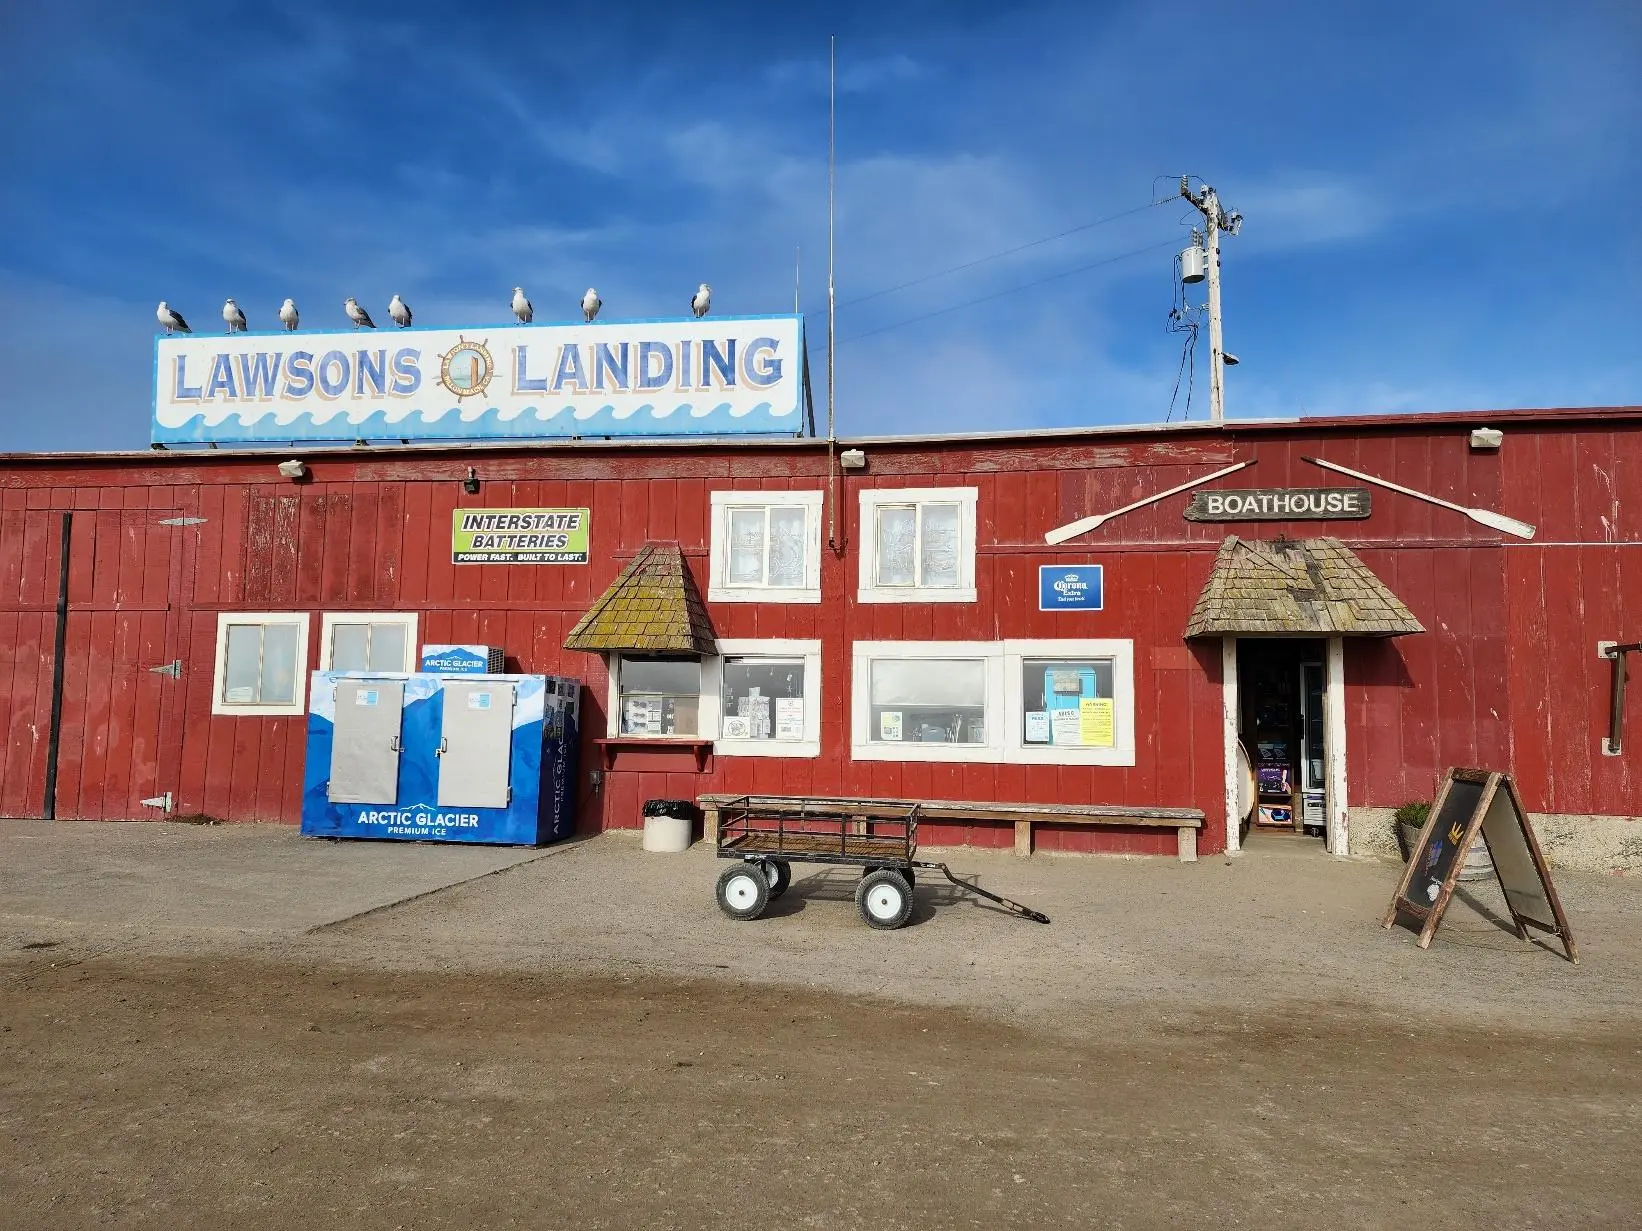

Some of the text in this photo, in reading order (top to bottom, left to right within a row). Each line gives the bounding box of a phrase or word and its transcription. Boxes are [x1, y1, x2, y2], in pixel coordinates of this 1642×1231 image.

[172, 336, 784, 402] LAWSONS LANDING
[1207, 493, 1360, 514] BOATHOUSE
[462, 514, 580, 530] INTERSTATE
[472, 534, 568, 549] BATTERIES
[458, 553, 488, 561] POWER
[517, 553, 541, 561] BUILT
[544, 553, 556, 561] TO
[1054, 580, 1088, 592] Corona
[425, 659, 484, 668] ARCTIC GLACIER
[553, 779, 561, 835] ARCTIC
[357, 811, 479, 827] ARCTIC GLACIER
[387, 826, 447, 836] PREMIUM ICE
